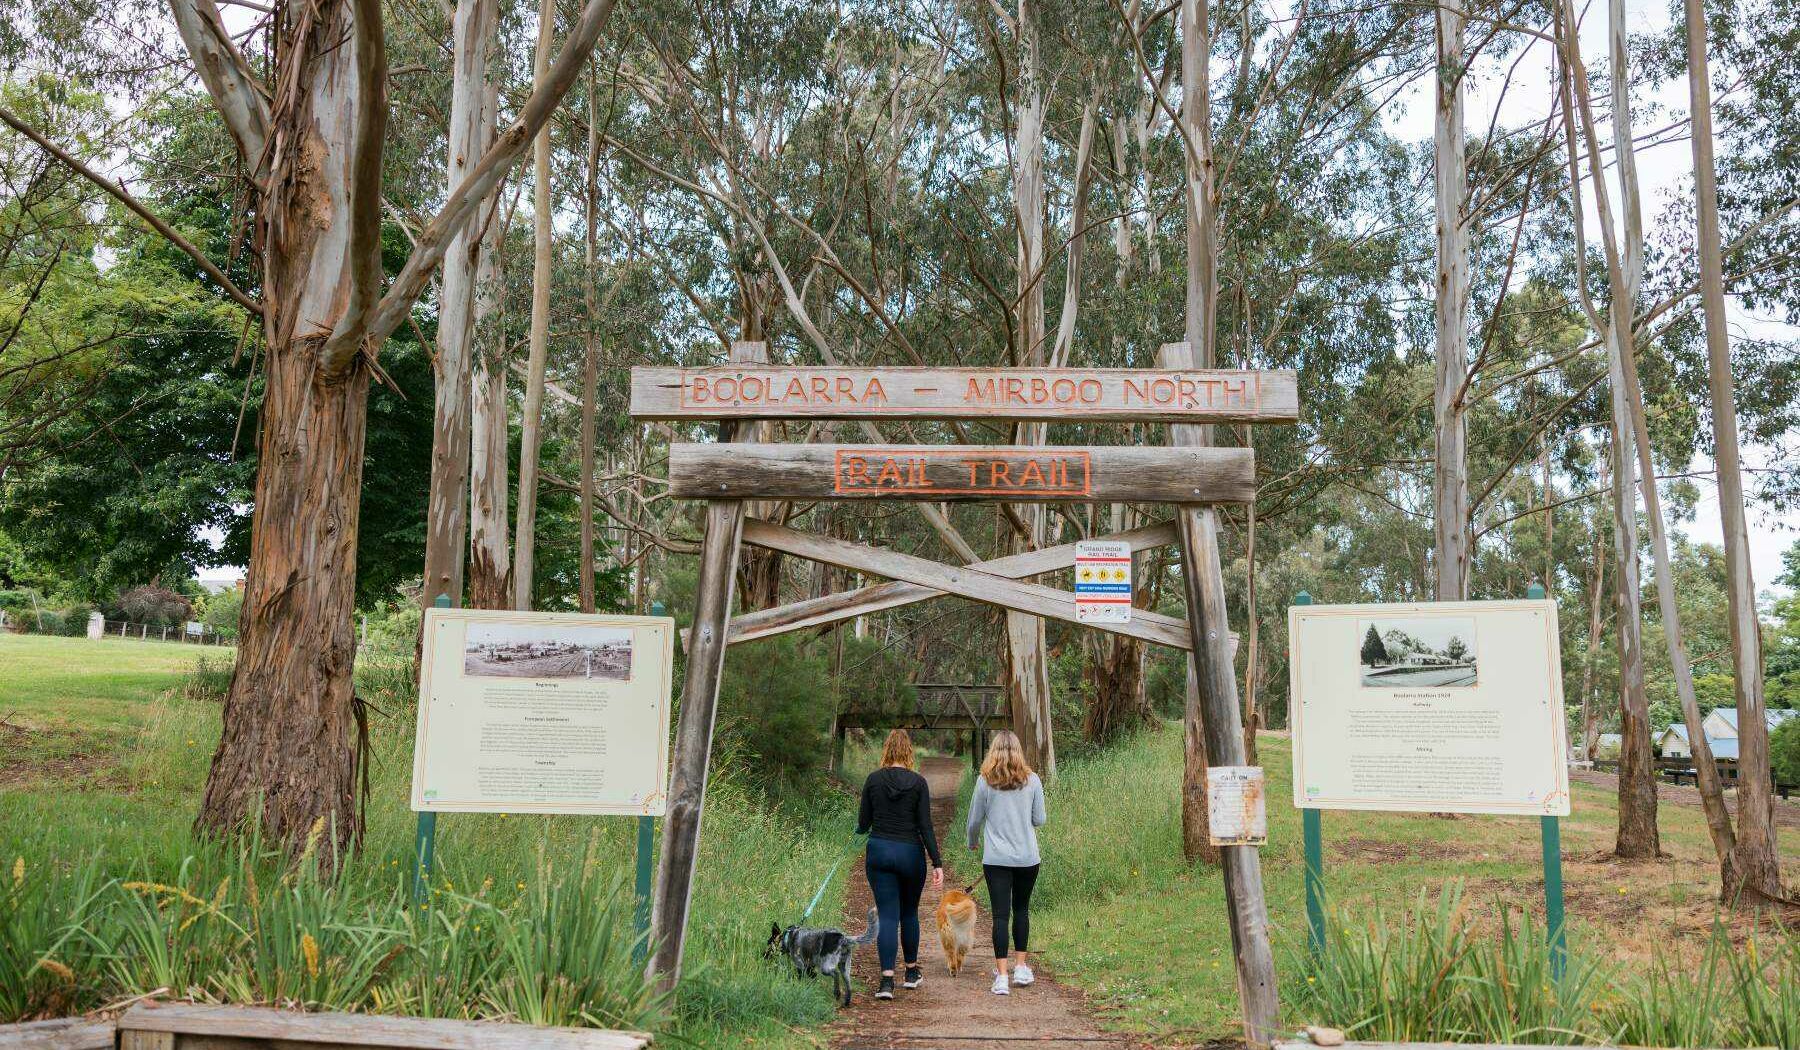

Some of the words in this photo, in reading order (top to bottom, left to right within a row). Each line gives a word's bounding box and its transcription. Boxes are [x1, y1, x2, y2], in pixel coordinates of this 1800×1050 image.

[693, 376, 888, 403] BOOLARRA
[963, 377, 1102, 404] MIRBOO
[1124, 378, 1247, 407] NORTH
[849, 457, 933, 487] RAIL
[961, 458, 1077, 488] TRAIL
